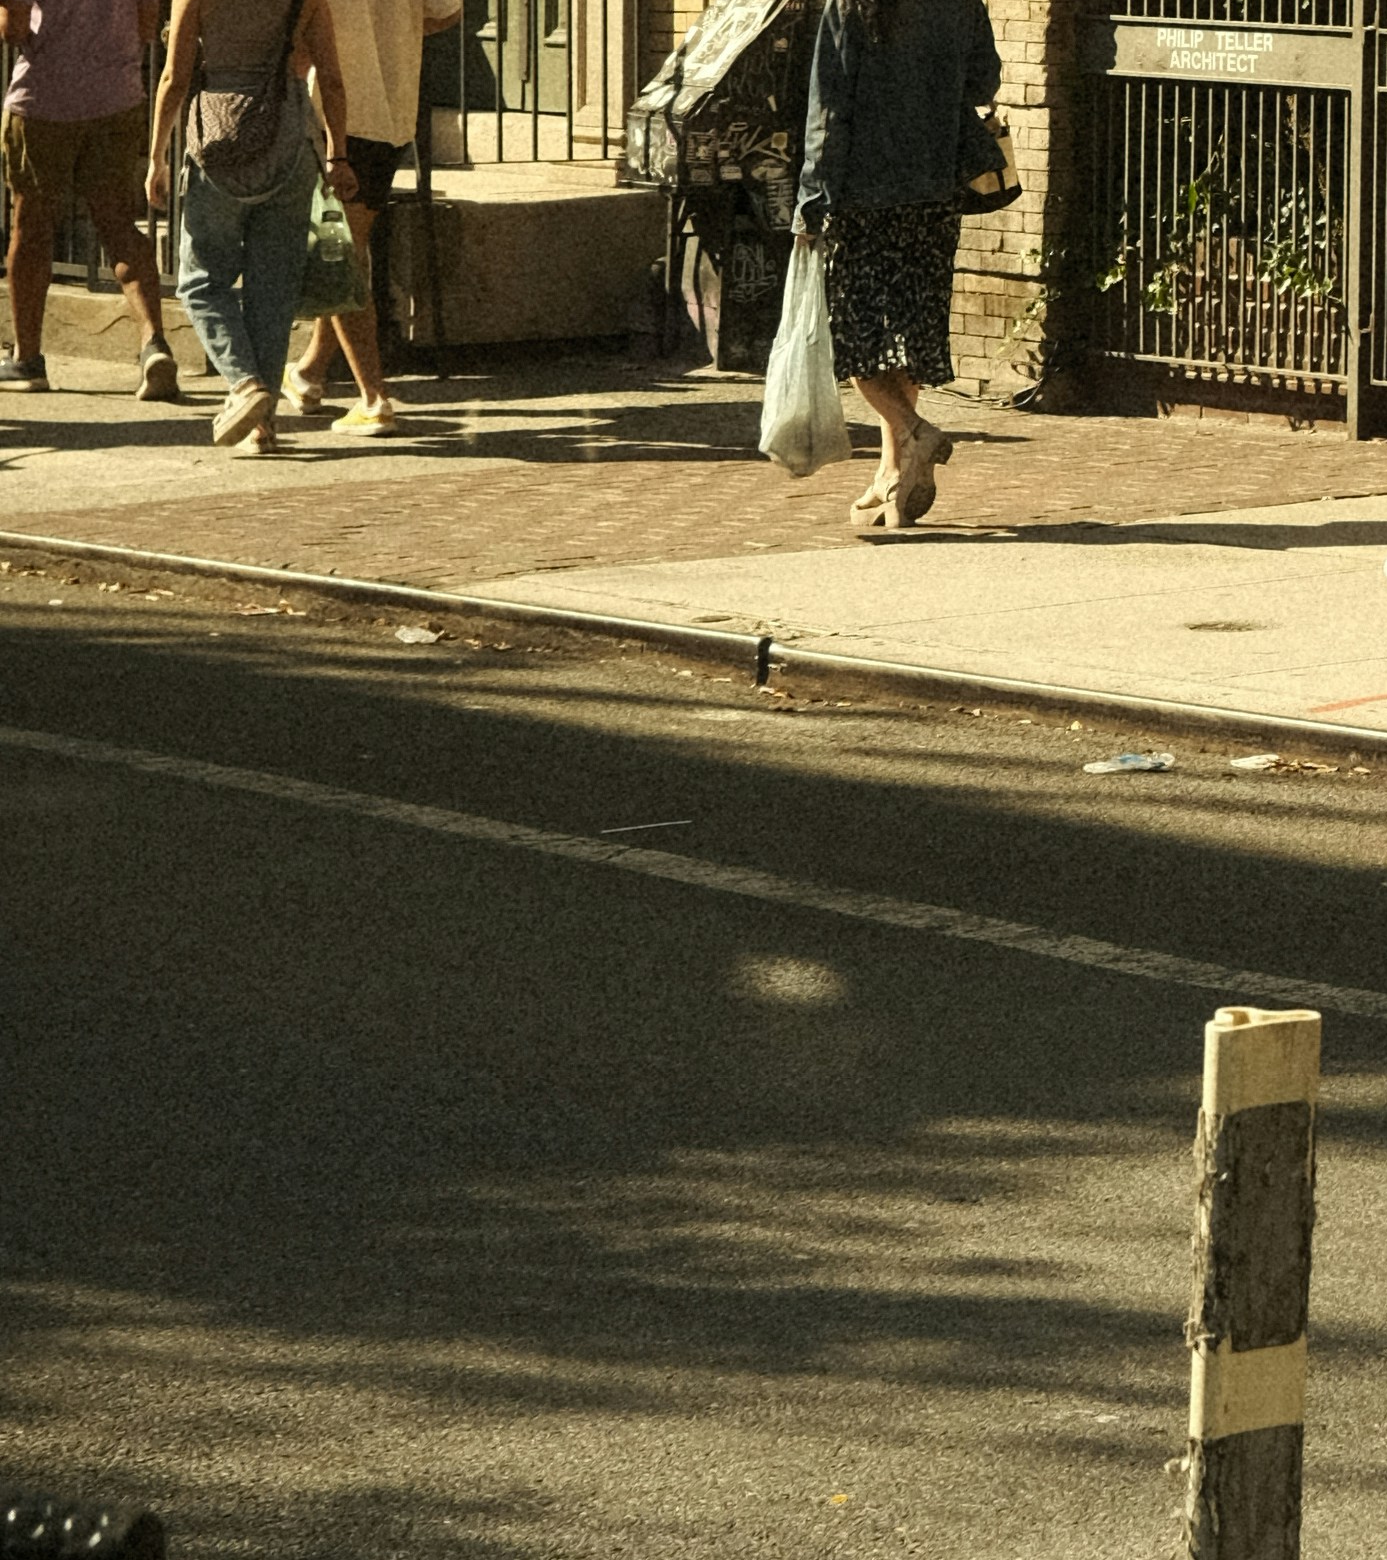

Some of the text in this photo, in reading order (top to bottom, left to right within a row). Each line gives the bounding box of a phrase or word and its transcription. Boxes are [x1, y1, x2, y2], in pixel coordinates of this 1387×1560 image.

[1156, 28, 1273, 53] PHILIP TELLER
[1170, 49, 1258, 74] ARCHITECT
